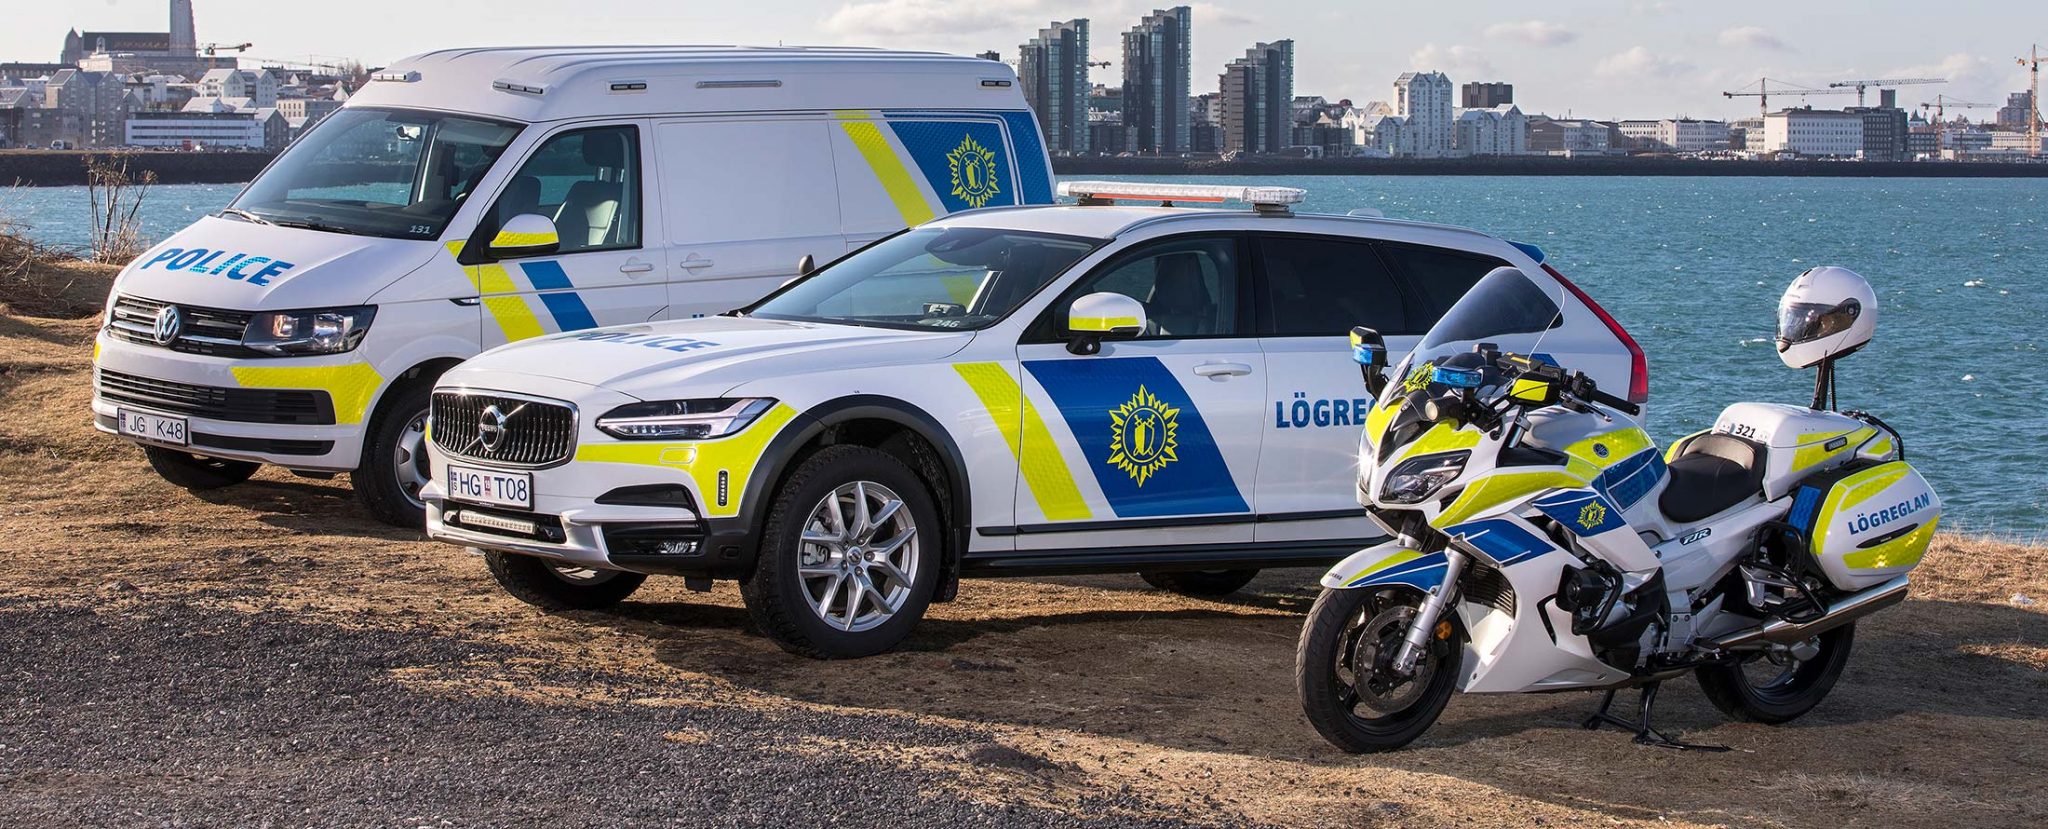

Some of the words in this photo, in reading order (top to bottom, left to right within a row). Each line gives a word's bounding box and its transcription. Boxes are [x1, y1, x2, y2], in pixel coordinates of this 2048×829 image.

[409, 225, 430, 234] 131
[140, 248, 295, 287] POLICE
[931, 320, 960, 328] 246
[130, 415, 146, 433] JG
[156, 419, 183, 440] K48
[1735, 423, 1756, 439] 321
[459, 472, 481, 496] HG
[494, 476, 527, 501] T08
[1848, 492, 1930, 535] LÖGREGLAN
